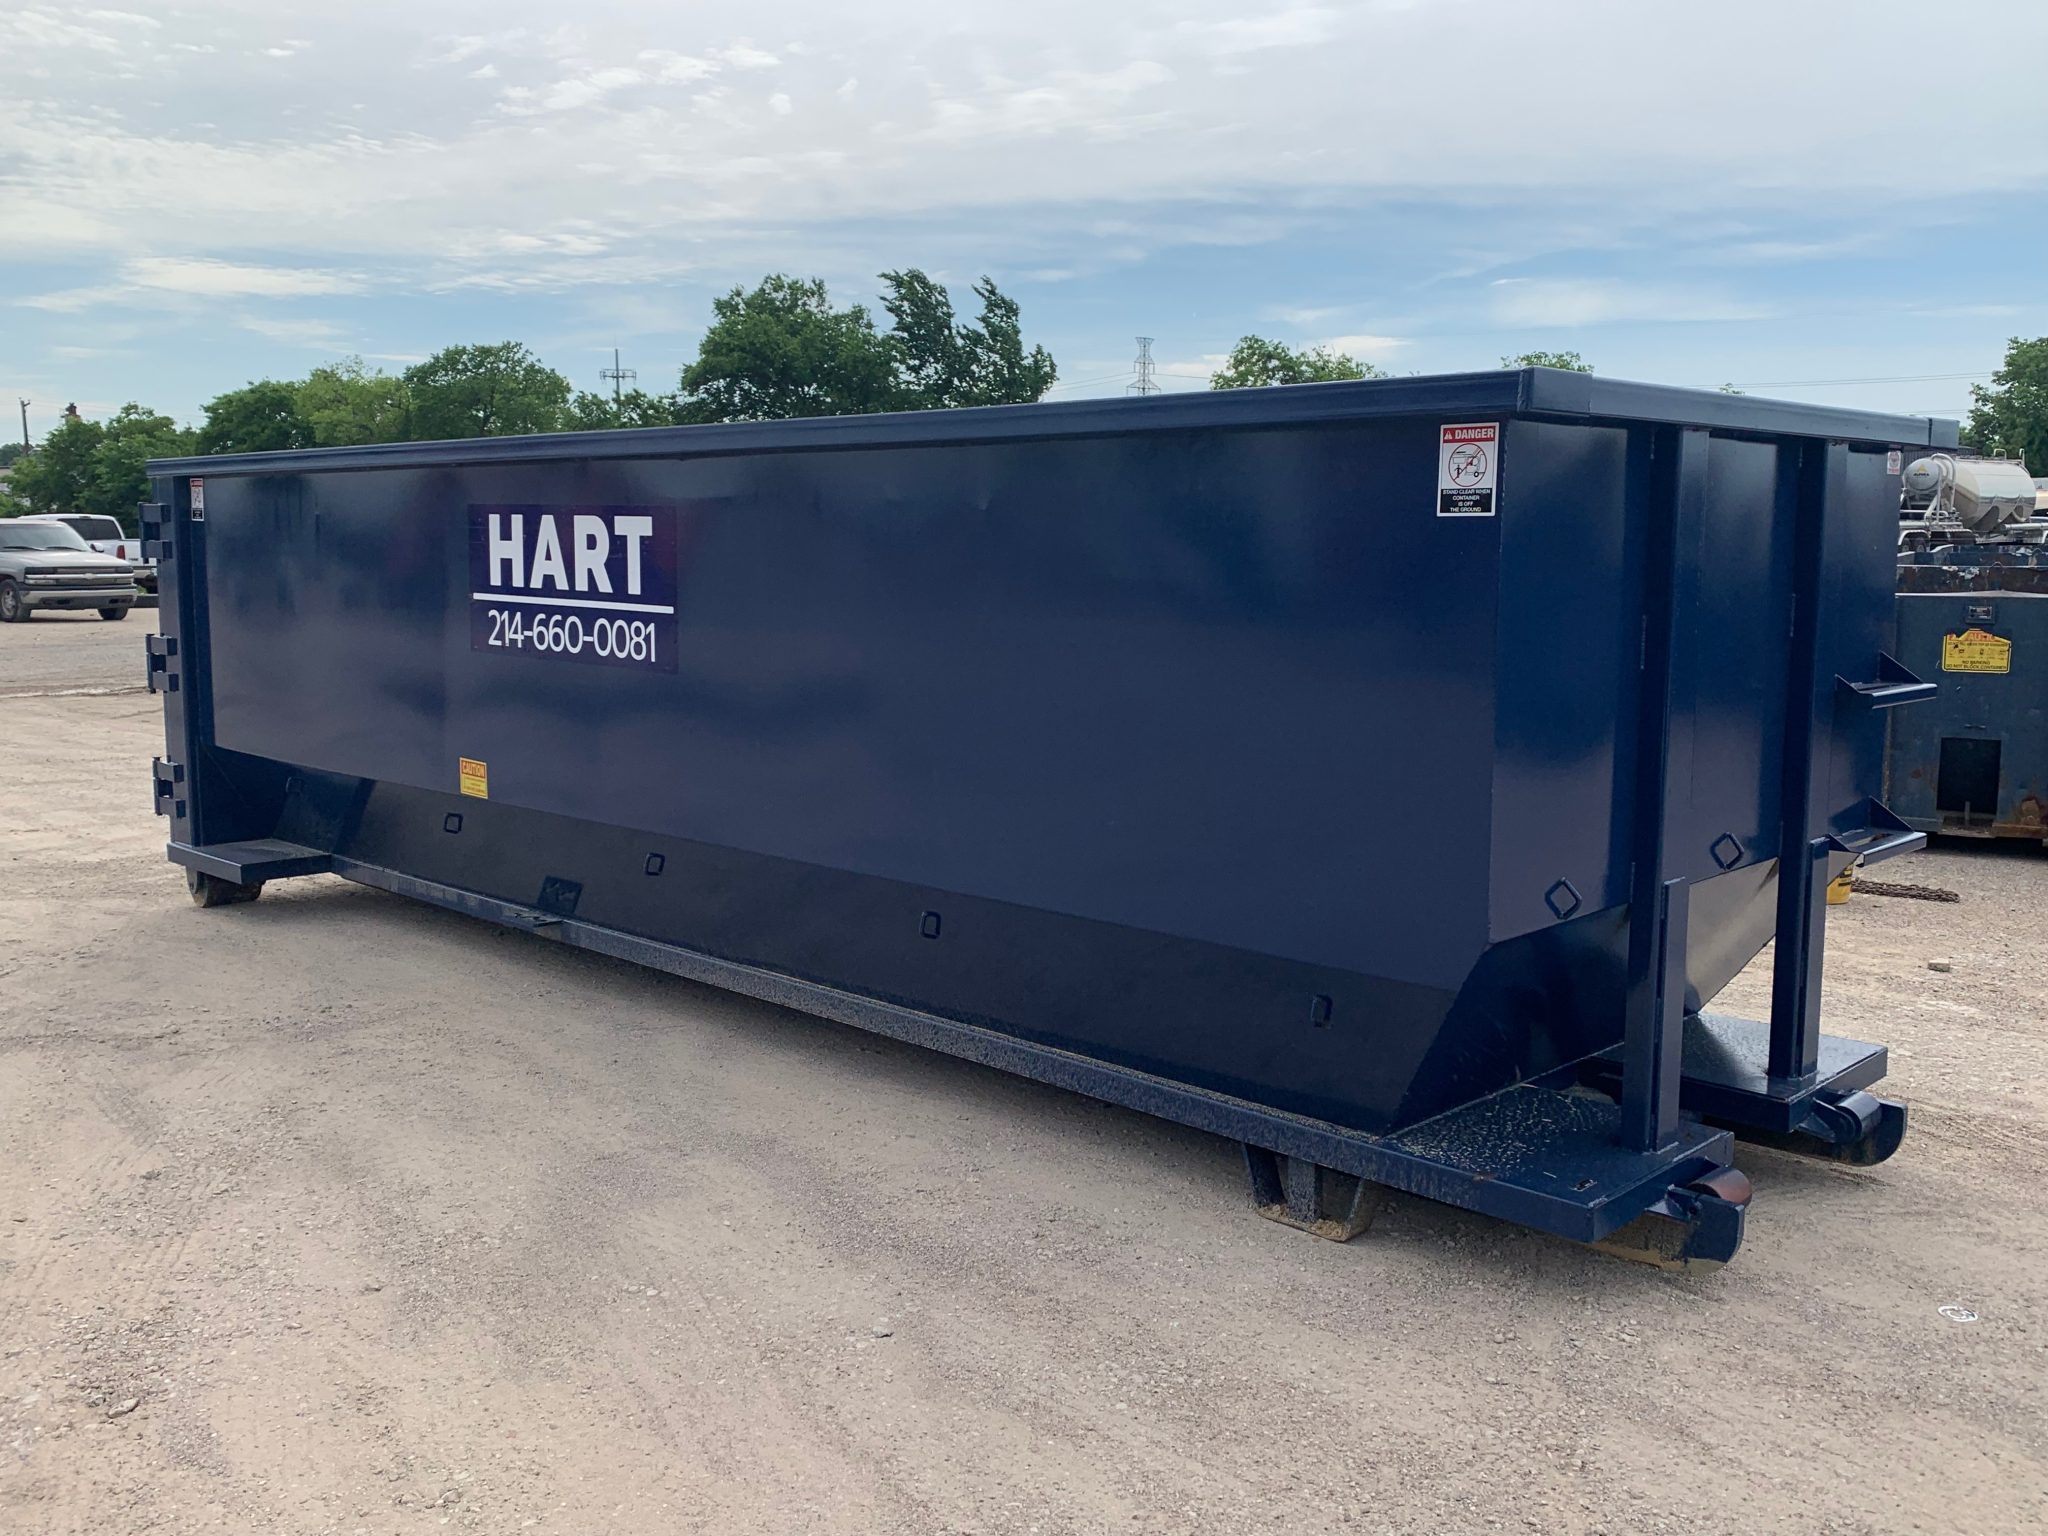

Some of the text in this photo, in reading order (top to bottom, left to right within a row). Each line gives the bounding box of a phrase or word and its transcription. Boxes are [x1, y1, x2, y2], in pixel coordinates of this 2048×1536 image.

[1455, 428, 1494, 439] DANGER
[488, 513, 653, 596] HART
[488, 609, 656, 663] 214-660-0081
